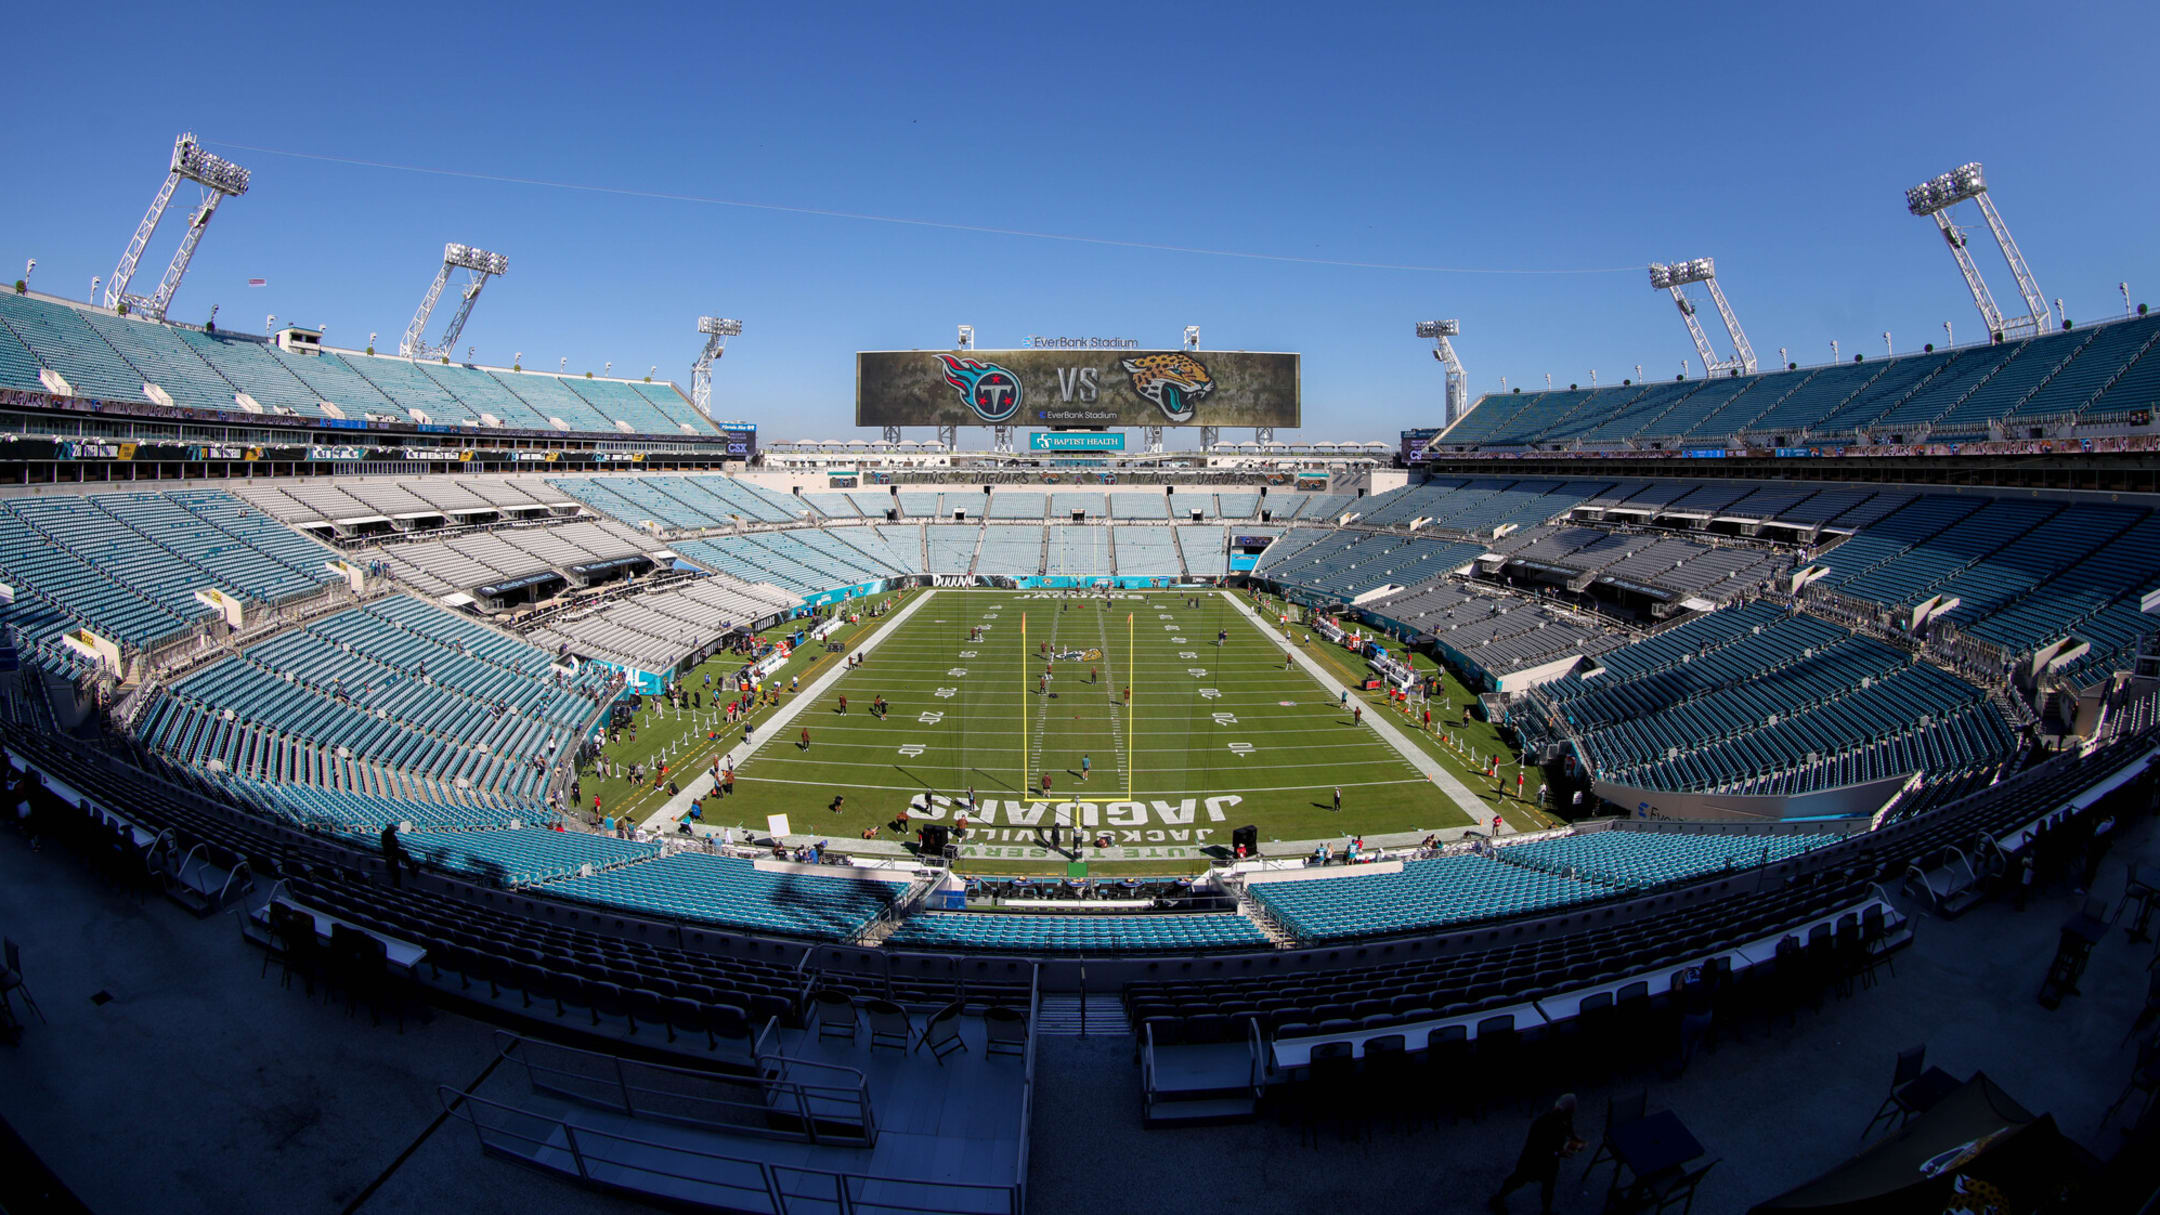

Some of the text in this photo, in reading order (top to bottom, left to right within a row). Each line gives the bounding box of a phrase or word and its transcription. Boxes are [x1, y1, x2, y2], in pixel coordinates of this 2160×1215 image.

[1034, 336, 1138, 348] EverBank Stadium
[1057, 367, 1098, 402] VS
[1047, 411, 1117, 419] EverBank Stadium
[728, 443, 747, 453] CSX
[902, 472, 946, 484] TITANS
[971, 472, 1029, 484] JAGUARS
[1129, 472, 1172, 485] TITANS
[1197, 473, 1255, 485] JAGUARS
[906, 793, 1243, 825] JAGUARS
[949, 828, 1214, 843] JACKSONVILL
